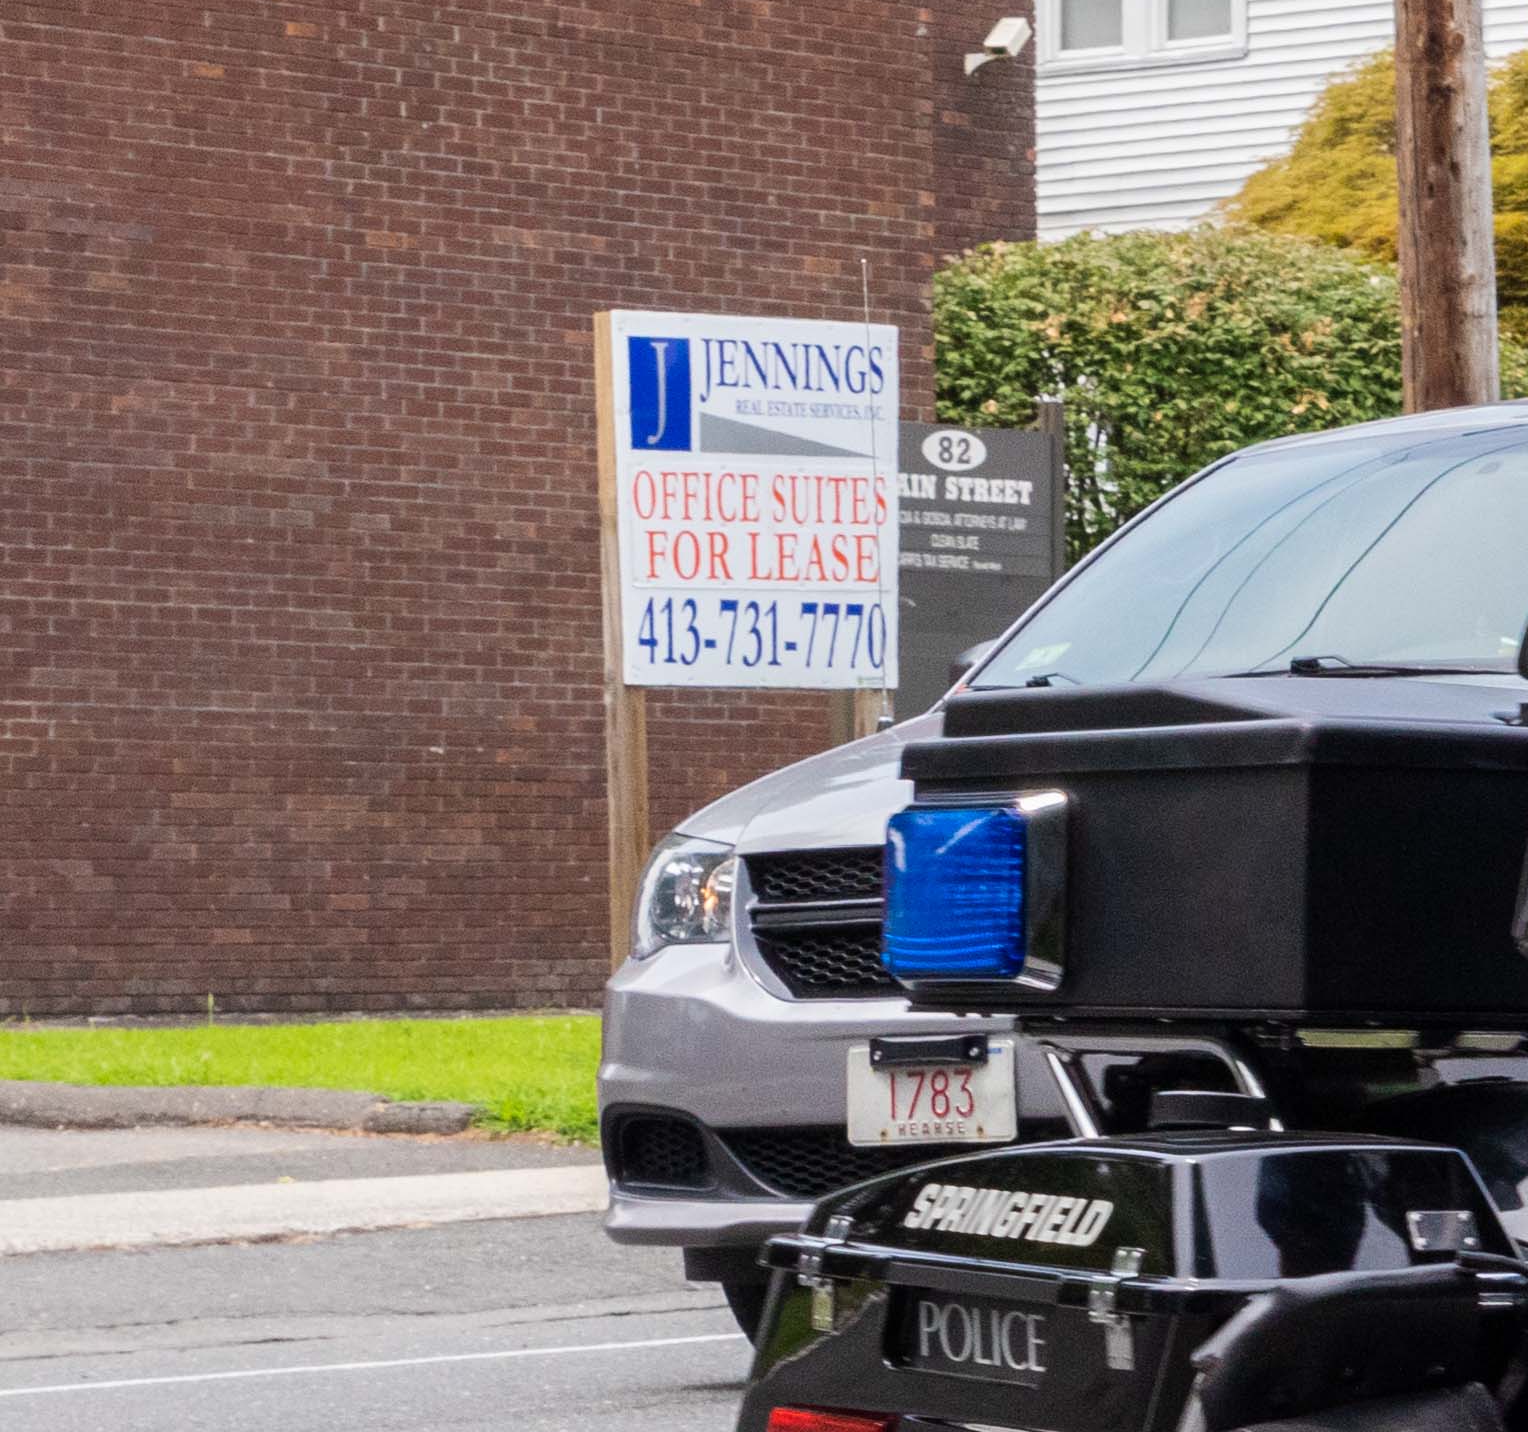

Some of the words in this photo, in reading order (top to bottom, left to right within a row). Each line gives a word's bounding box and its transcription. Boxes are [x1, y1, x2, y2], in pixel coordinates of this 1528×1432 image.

[700, 338, 885, 403] JENNINGS
[736, 399, 765, 415] REAL
[767, 400, 808, 417] ESTATE
[938, 436, 971, 465] 82
[633, 470, 760, 523] OFFICE
[771, 473, 888, 526] SUITES
[898, 472, 937, 500] AIN
[944, 476, 1033, 505] STREET
[645, 530, 734, 581] FOR
[747, 532, 880, 583] LEASE
[638, 597, 887, 669] 413-731-7770
[889, 1068, 975, 1121] 1783
[898, 1121, 967, 1136] HEARSE
[904, 1183, 1114, 1247] SPRINGFIELD
[919, 1300, 1047, 1372] POLICE
